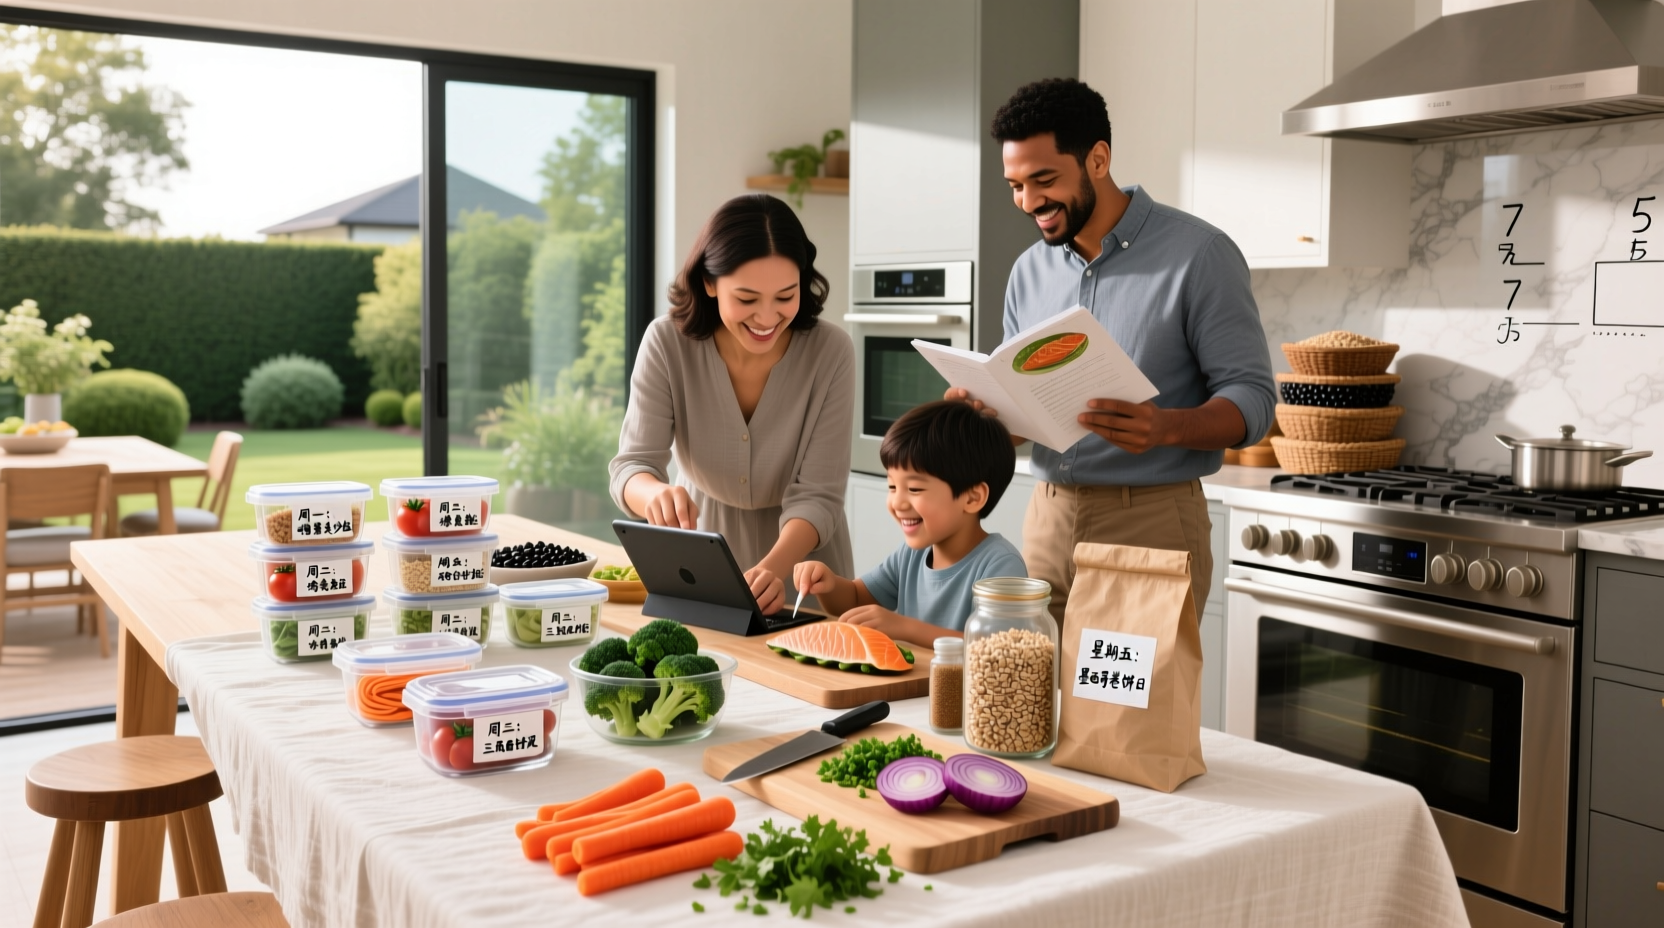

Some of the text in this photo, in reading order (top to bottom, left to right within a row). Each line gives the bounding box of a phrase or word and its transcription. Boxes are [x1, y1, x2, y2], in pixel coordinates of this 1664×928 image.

[1503, 204, 1523, 237] 7
[1632, 196, 1656, 233] 5
[1503, 280, 1521, 310] 7
